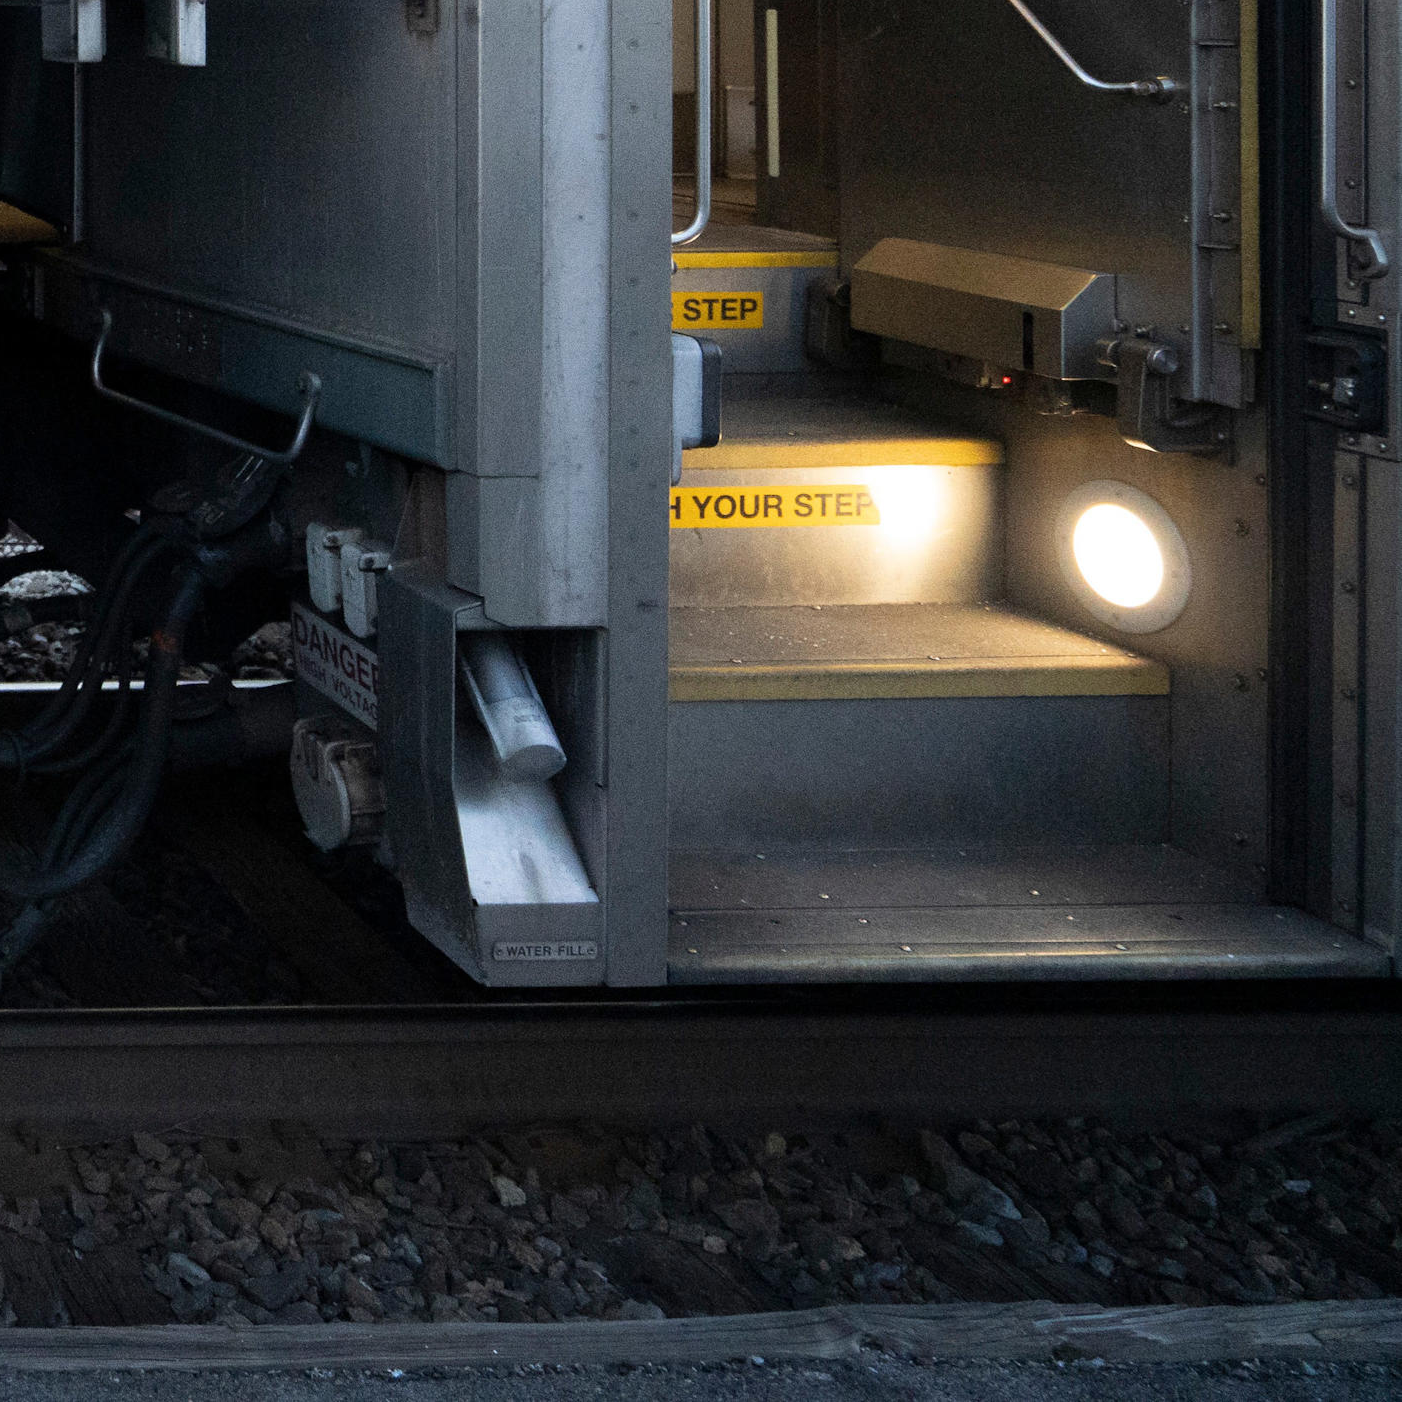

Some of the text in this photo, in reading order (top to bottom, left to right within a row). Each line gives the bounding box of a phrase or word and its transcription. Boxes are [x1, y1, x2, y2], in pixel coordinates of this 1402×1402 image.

[683, 298, 757, 321] STEP
[692, 495, 783, 519] YOUR
[794, 493, 870, 518] STEP
[332, 675, 379, 719] VOLTAG
[506, 945, 584, 956] WATER FILL
